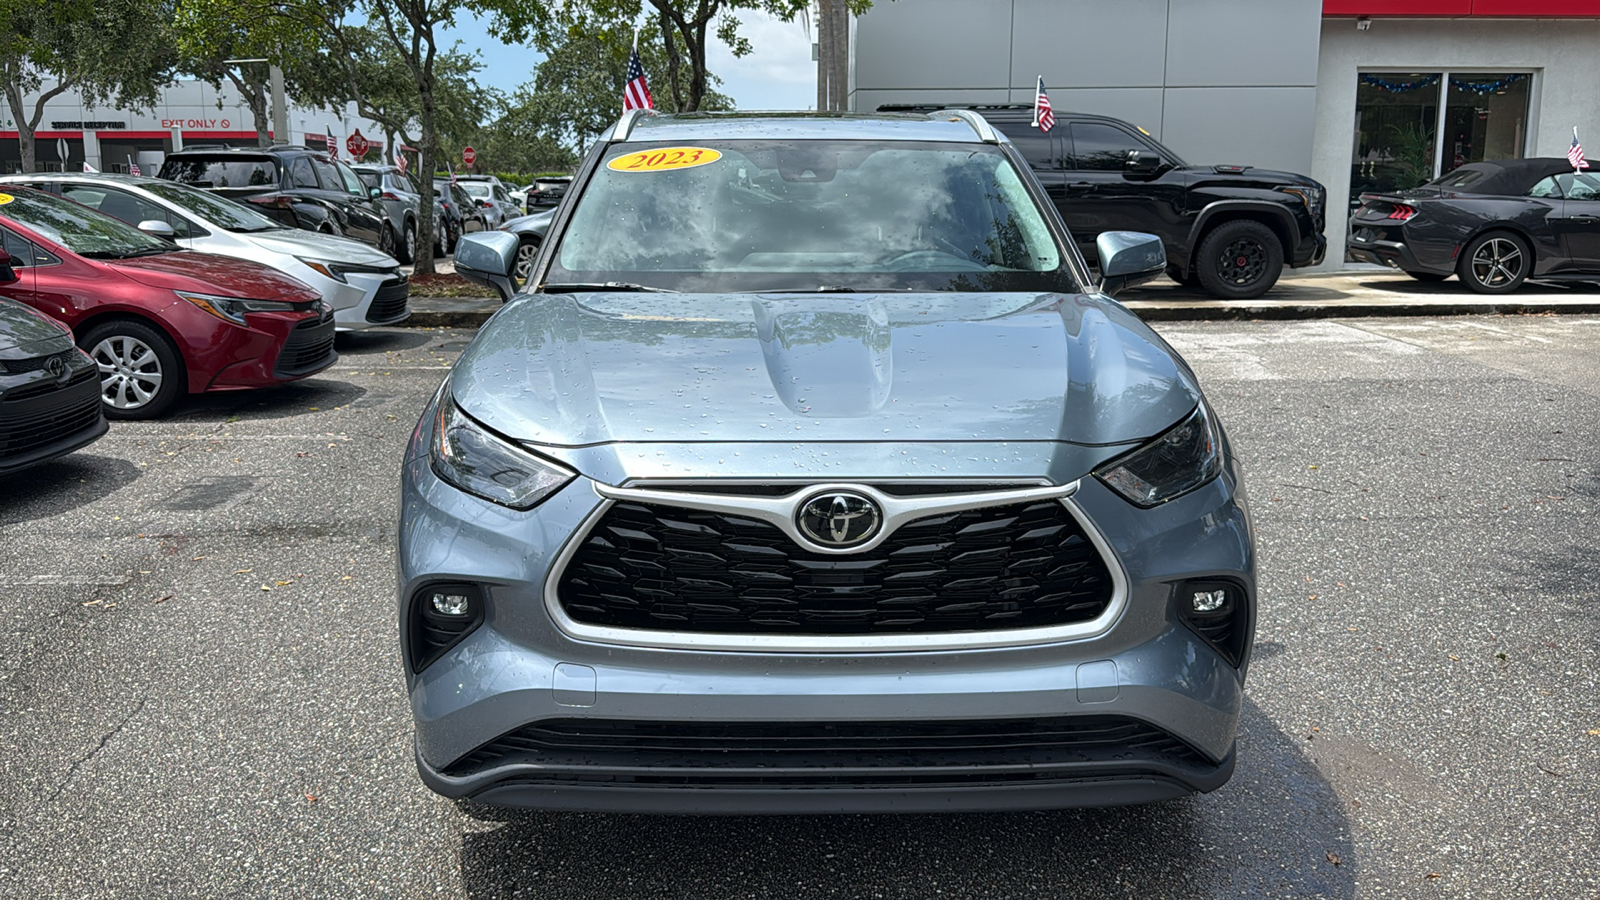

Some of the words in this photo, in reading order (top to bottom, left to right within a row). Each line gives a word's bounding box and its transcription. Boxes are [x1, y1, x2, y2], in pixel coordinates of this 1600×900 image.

[161, 119, 184, 128] EXIT
[188, 119, 216, 128] ONLY
[348, 141, 367, 150] STP
[627, 150, 704, 169] 2023
